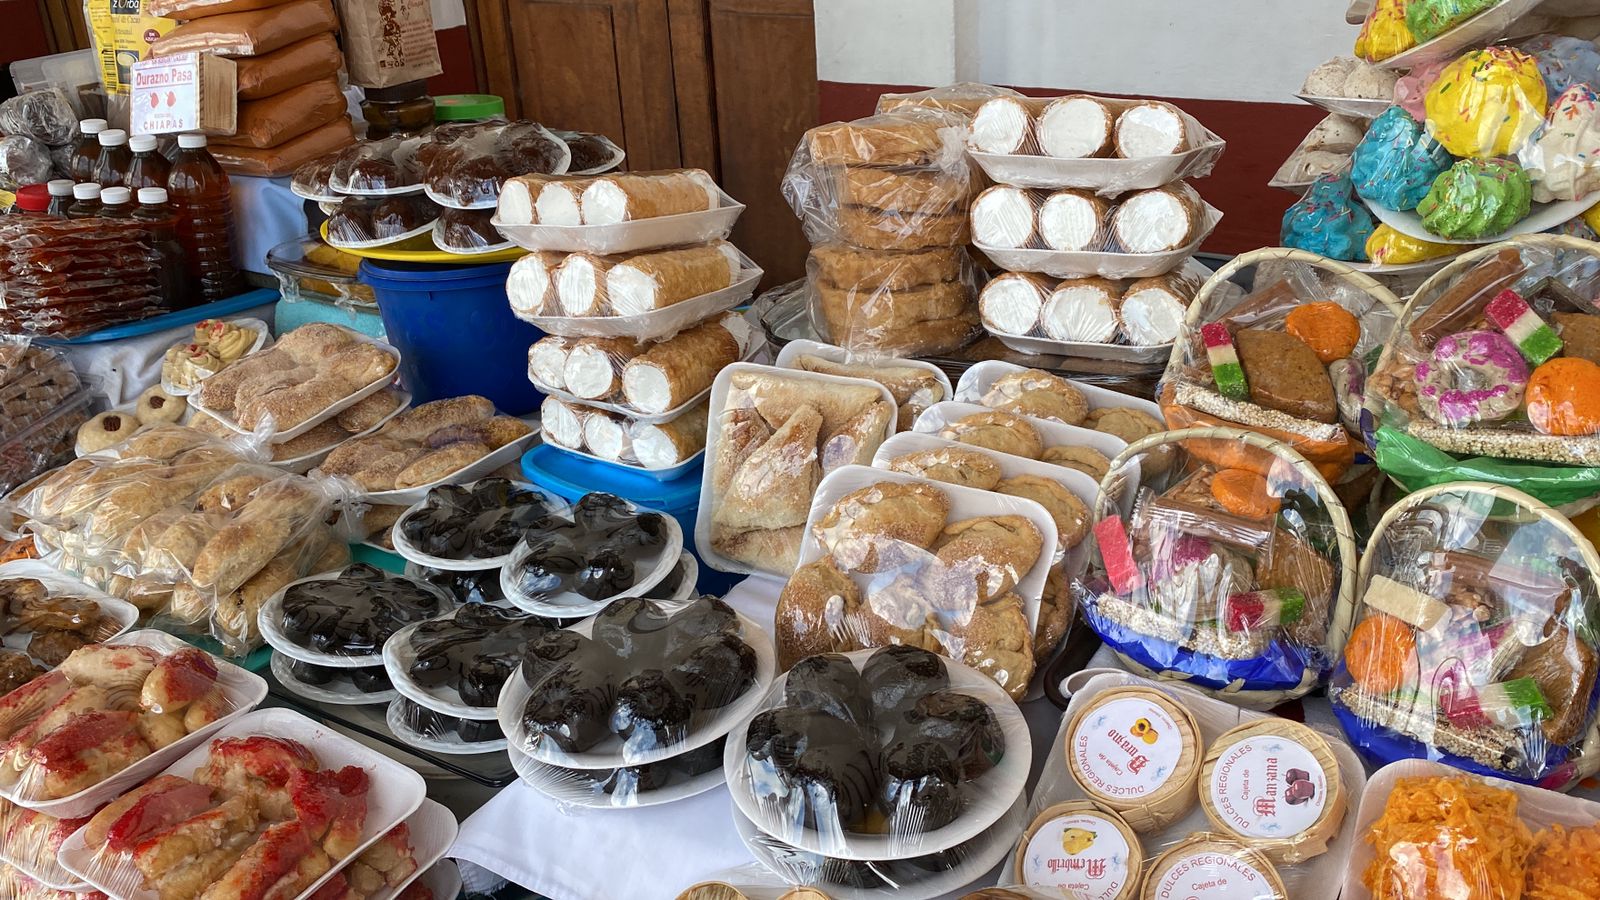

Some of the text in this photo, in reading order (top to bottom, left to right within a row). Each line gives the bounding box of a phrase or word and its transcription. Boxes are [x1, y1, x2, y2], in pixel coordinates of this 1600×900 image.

[136, 69, 193, 86] Durazno Pasa
[143, 119, 184, 131] CHIAPAS
[1079, 735, 1145, 795] DULCES REGIONALES
[1097, 752, 1124, 776] Cajeta de
[1106, 728, 1150, 776] Durazno
[1218, 744, 1253, 830] DULCES REGIONALES
[1241, 769, 1251, 801] Cajeta de
[1252, 757, 1280, 817] Manzana
[1046, 858, 1107, 880] Membrillo
[1161, 856, 1256, 899] DULCES REGIONALES
[1067, 882, 1090, 891] Cajeta
[1191, 878, 1227, 891] Cajeta de
